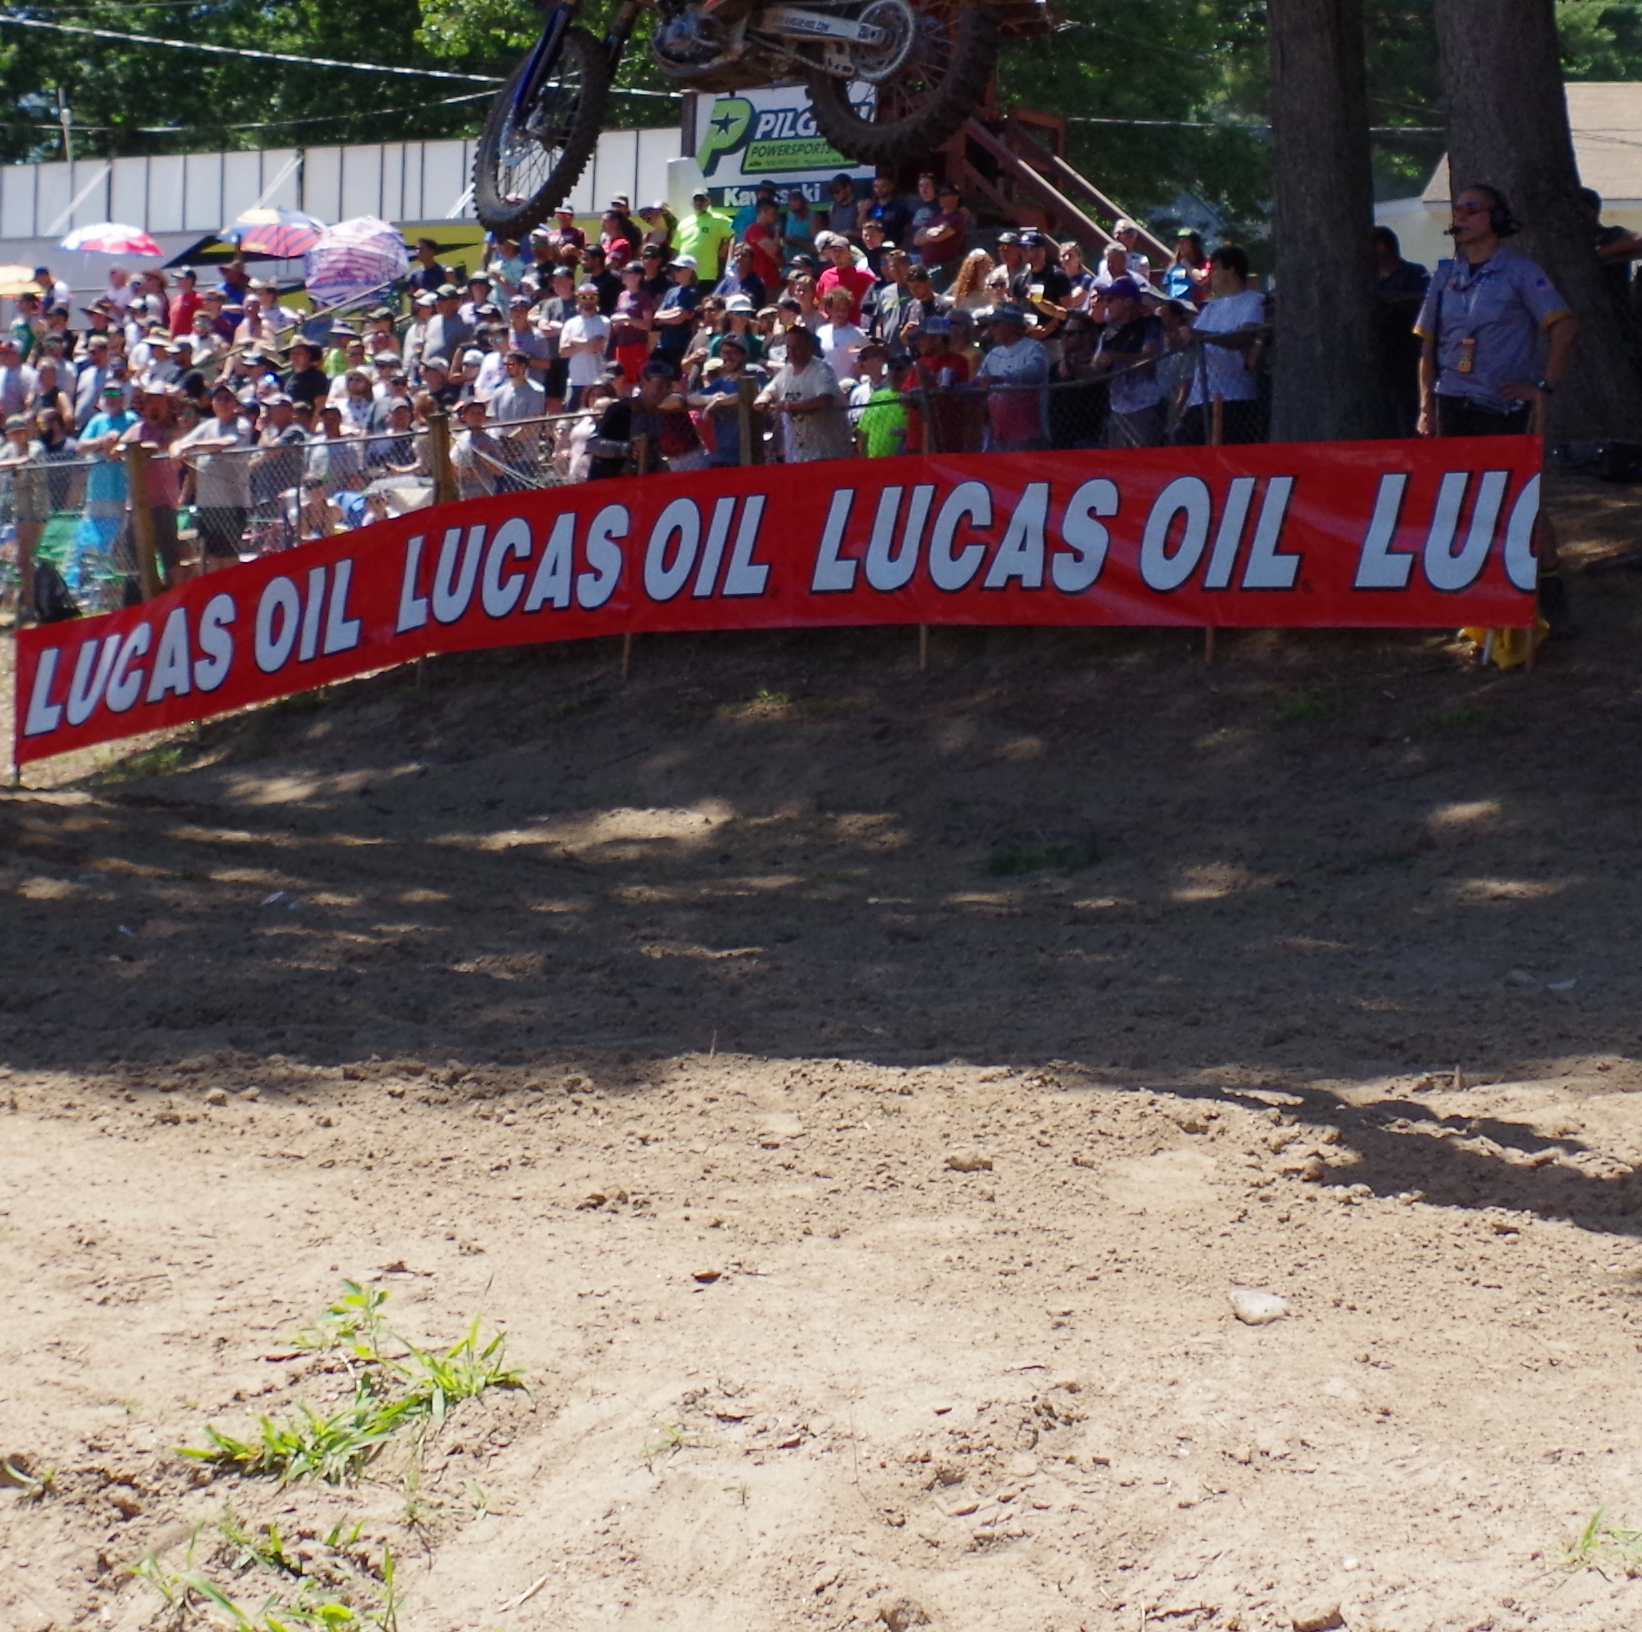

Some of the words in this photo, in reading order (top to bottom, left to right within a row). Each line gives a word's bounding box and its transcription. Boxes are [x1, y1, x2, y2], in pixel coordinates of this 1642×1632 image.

[23, 593, 237, 737] LUCAS
[254, 557, 362, 674] OIL
[395, 502, 627, 634] LUCAS
[642, 493, 771, 601] OIL
[810, 478, 1119, 593] LUCAS
[1139, 474, 1303, 590] OIL
